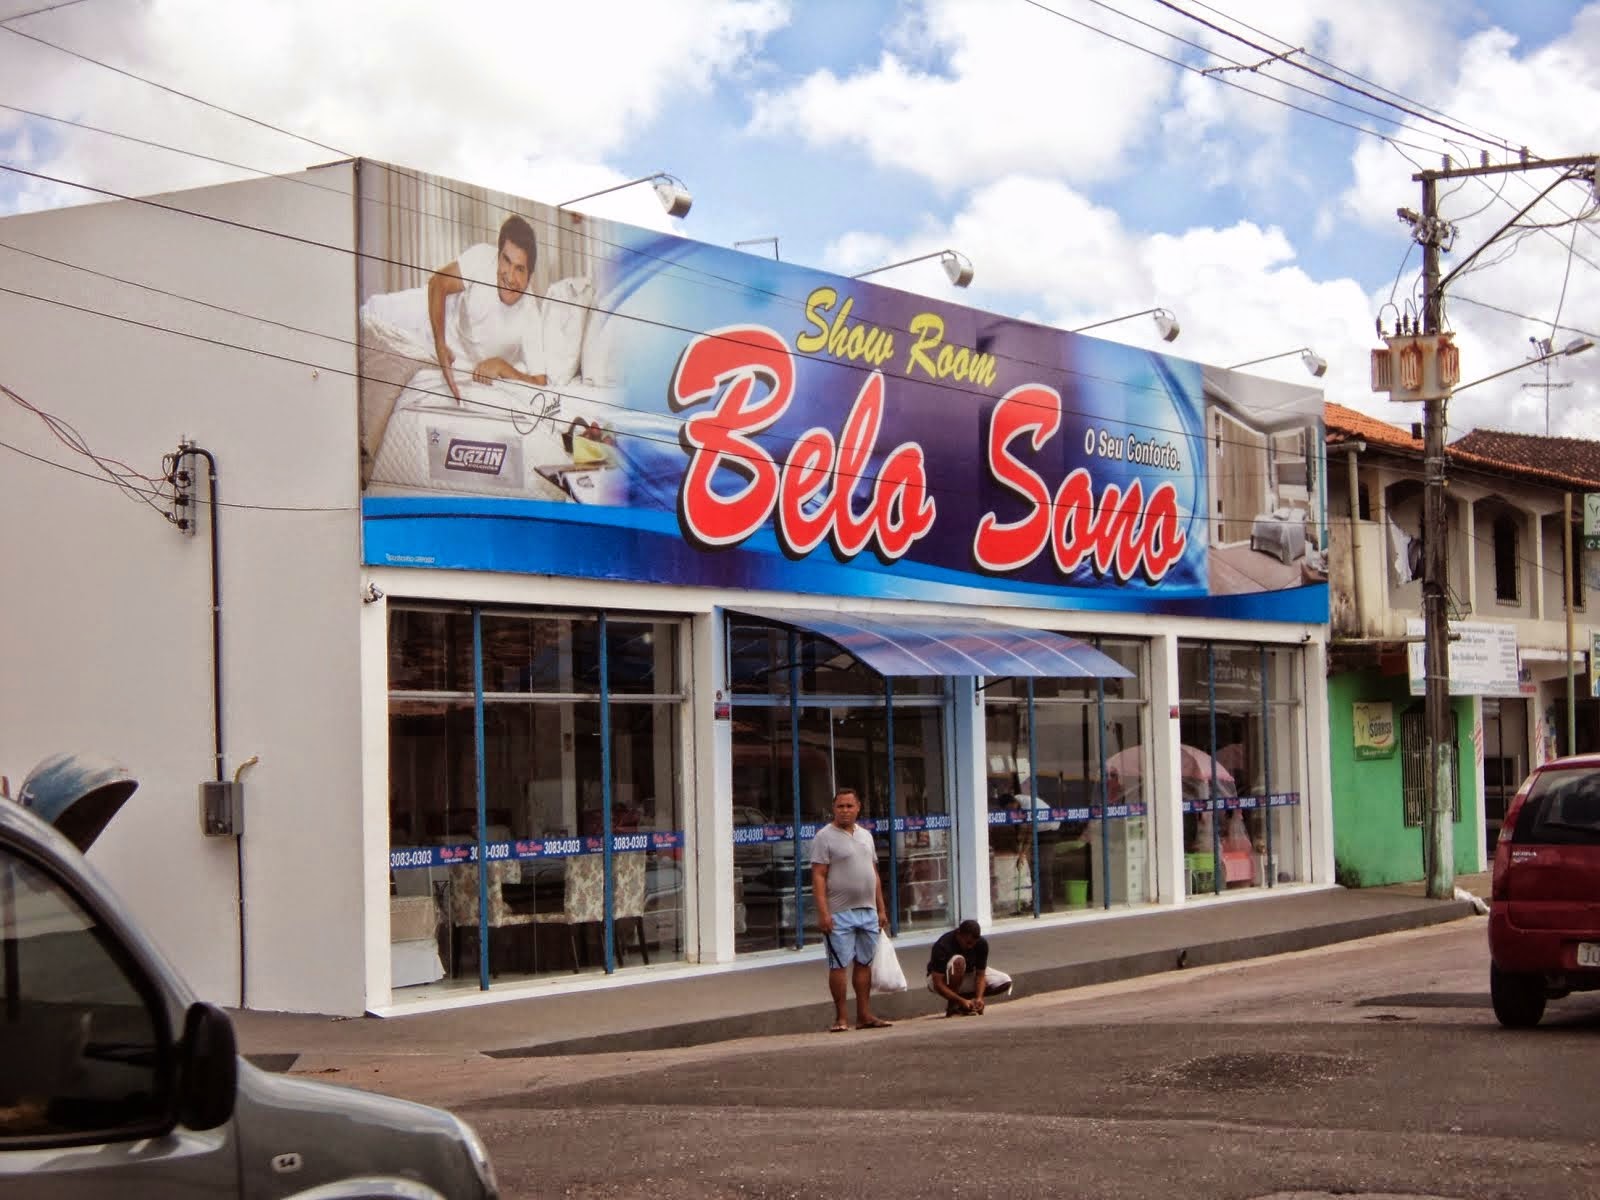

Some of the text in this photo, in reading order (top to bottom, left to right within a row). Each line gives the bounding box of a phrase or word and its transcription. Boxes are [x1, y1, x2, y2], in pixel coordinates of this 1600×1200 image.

[796, 287, 997, 388] Show Room
[450, 444, 504, 467] GAZIN
[672, 324, 1185, 583] Belo Sono
[1084, 428, 1181, 471] O Seu Conforto.
[390, 850, 432, 867] 3083-0303
[544, 839, 580, 855] 3083-0303
[613, 836, 647, 850] 3083-0303
